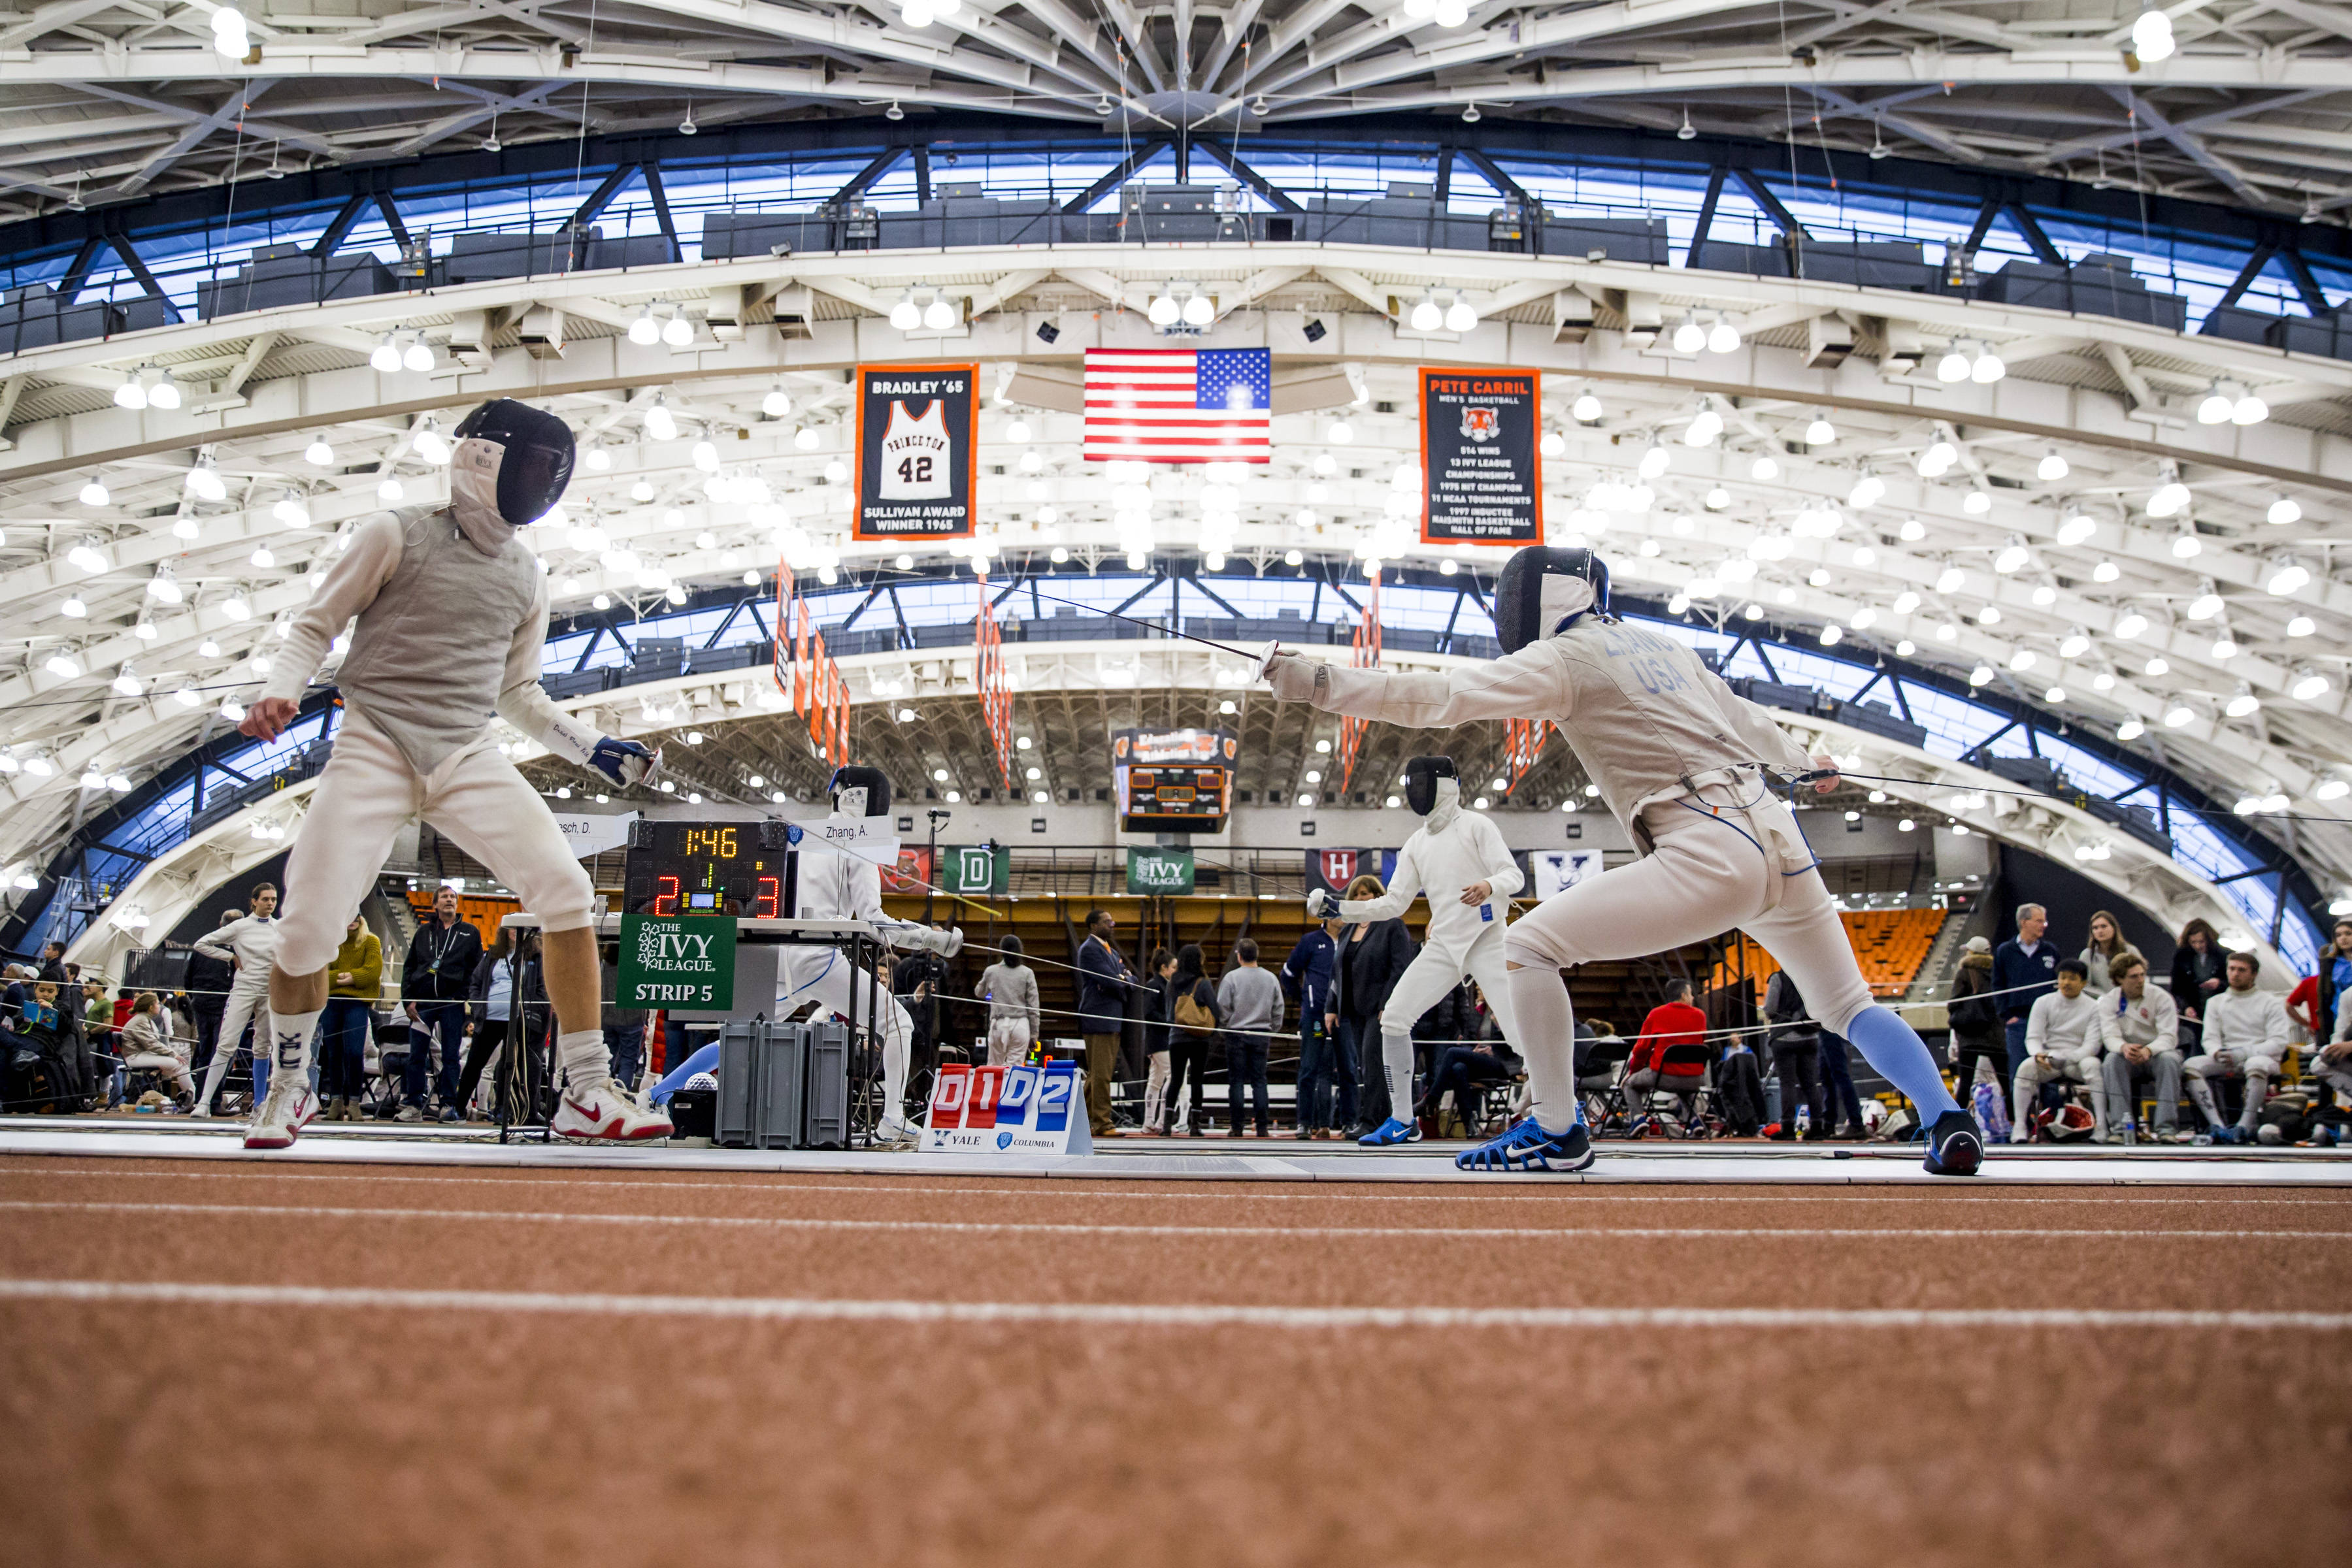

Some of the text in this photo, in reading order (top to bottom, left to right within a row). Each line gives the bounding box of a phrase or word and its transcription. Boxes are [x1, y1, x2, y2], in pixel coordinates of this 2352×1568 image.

[872, 381, 939, 394] BRADLEY
[1430, 380, 1529, 395] PETE CARRIL
[1439, 395, 1520, 404] MEN'S BASKETBALL
[887, 435, 946, 452] PRINCETON
[1477, 446, 1501, 455] WINS
[1450, 458, 1512, 468] 13 IVY LEAGUE
[898, 457, 932, 483] 42
[1445, 470, 1516, 480] CHAMPIONSHIPS
[1440, 482, 1523, 493] 1975 NIT CHAMPION
[1431, 493, 1532, 505] 11 NCAA TOURNAMENTS
[864, 506, 966, 518] SULLIVAN AWARD
[1449, 506, 1514, 517] 1997 INDUCTEE
[876, 519, 954, 531] WINNER 1965
[1432, 515, 1532, 526] NAISMITH BASKETBALL
[1451, 525, 1512, 535] HALL OF FAME
[1629, 657, 1693, 694] USA
[582, 822, 591, 834] D.
[826, 825, 868, 840] Zhang, A.
[686, 828, 737, 858] 1:46
[959, 848, 993, 890] D
[1148, 862, 1184, 877] IVY
[1329, 853, 1349, 879] H
[1148, 877, 1185, 886] LEAGUE
[655, 876, 779, 919] 2 3
[660, 923, 681, 932] THE
[657, 934, 714, 958] IVY
[657, 960, 712, 972] LEAGUE
[635, 984, 714, 1002] STRIP 5
[952, 1135, 981, 1146] YALE
[1014, 1139, 1055, 1149] COLUMBIA
